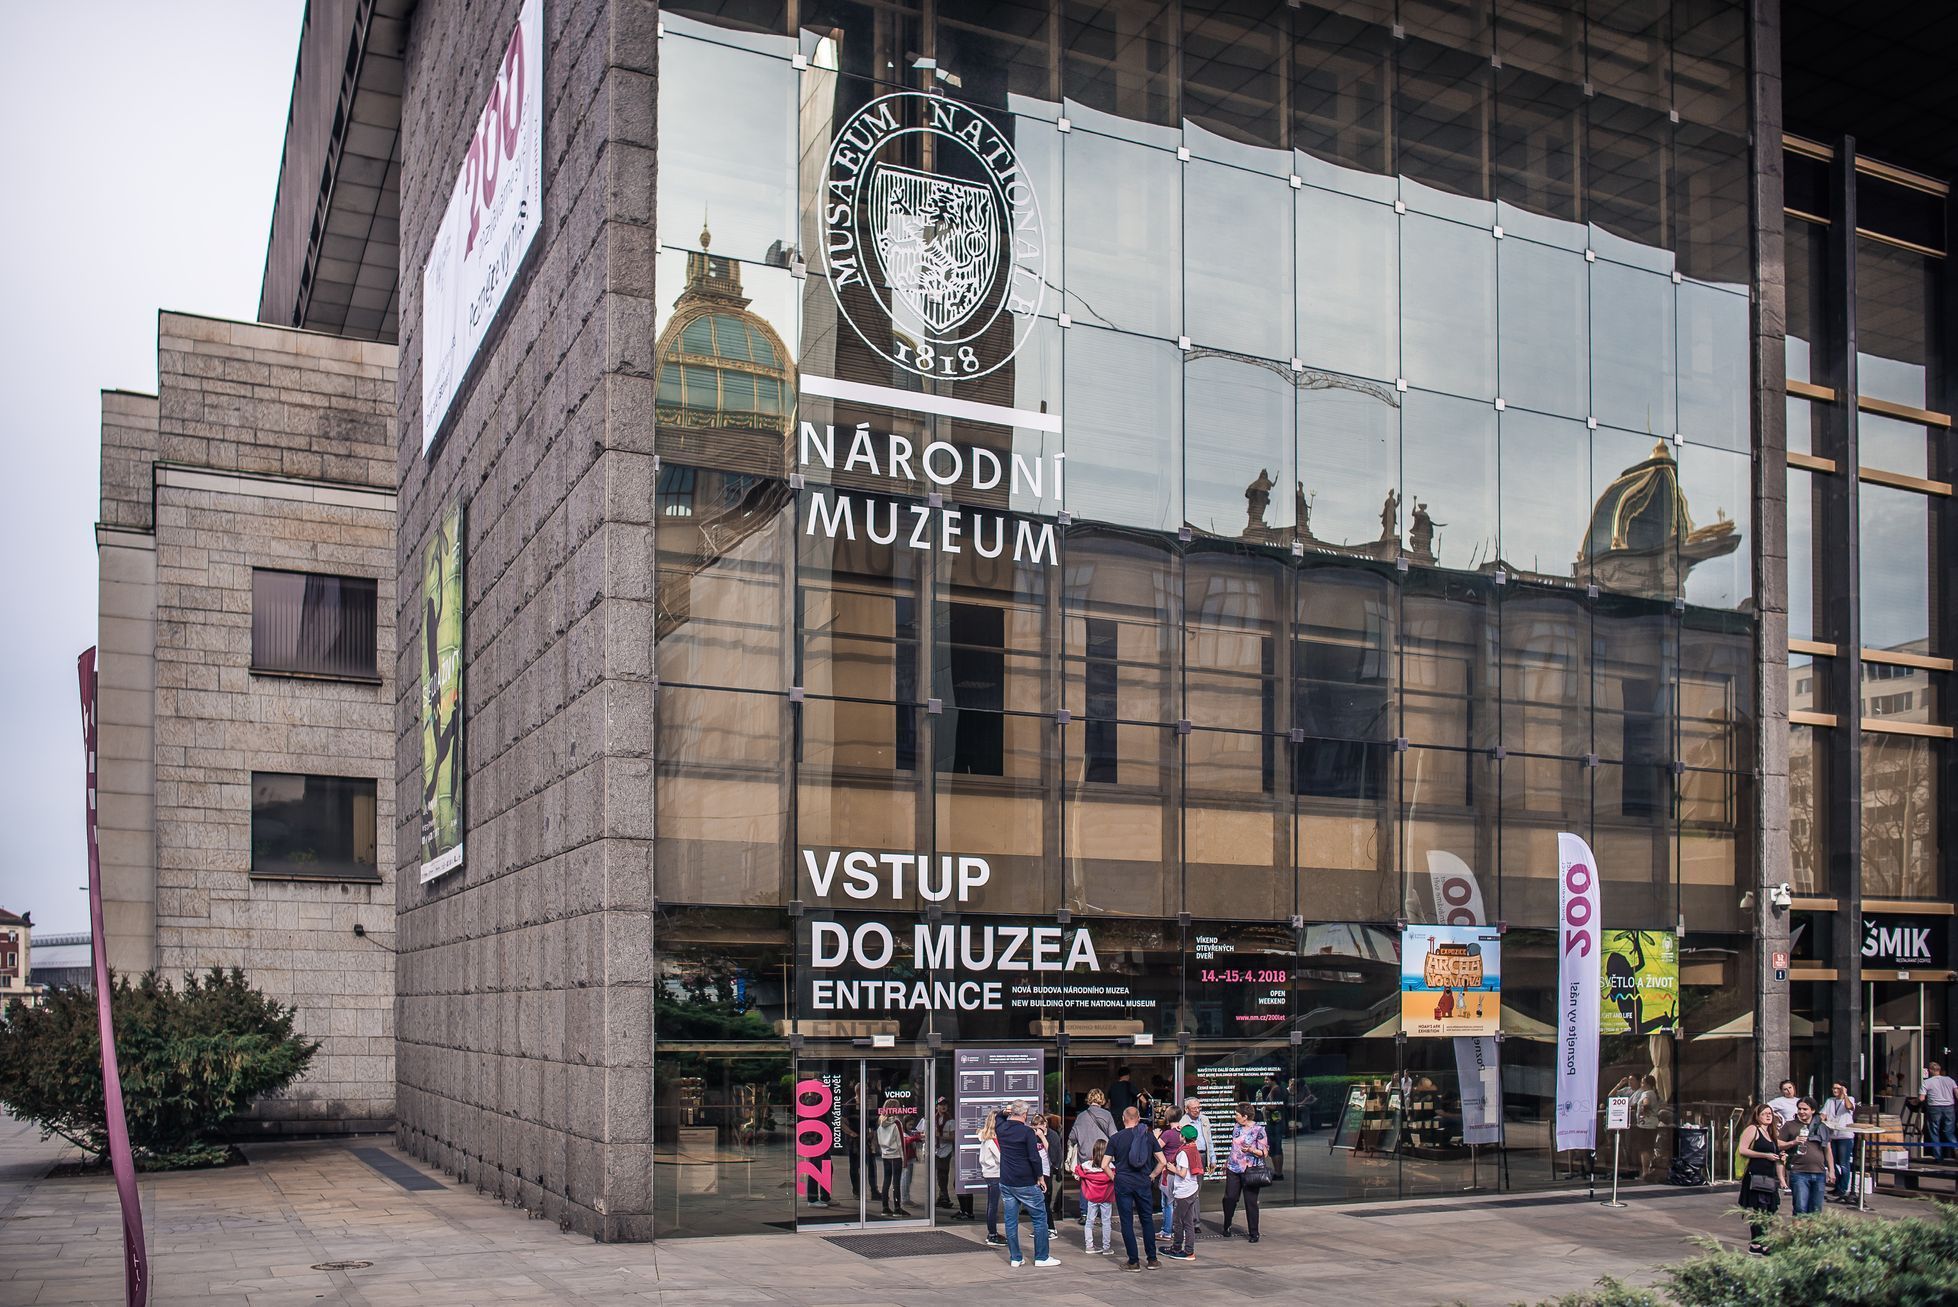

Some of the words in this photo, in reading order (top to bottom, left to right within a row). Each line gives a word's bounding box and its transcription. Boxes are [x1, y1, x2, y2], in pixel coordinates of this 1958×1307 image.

[464, 20, 525, 263] 200
[824, 99, 900, 294] MUSAEUM
[930, 99, 1043, 321] NATIONALE
[894, 340, 979, 377] 1818
[800, 420, 1066, 502] NÁRODNÍ
[806, 491, 1060, 566] MUZEUM
[803, 849, 991, 902] VSTUP
[811, 921, 894, 970] DO
[913, 923, 1100, 972] MUZEA
[1196, 935, 1218, 944] VÍKEND
[1196, 944, 1234, 952] OTEVŘENÝCH
[1861, 920, 1931, 958] ŠMIK
[1196, 952, 1214, 960] DVEŘÍ
[1012, 985, 1031, 994] NOVÁ
[1033, 986, 1062, 994] BUDOVA
[1063, 985, 1104, 994] NÁRODNÍHO
[1245, 970, 1256, 982] 4.
[1258, 970, 1286, 982] 2018
[1599, 974, 1635, 988] SVĚTLO
[1637, 977, 1644, 988] A
[1646, 974, 1673, 988] ŽIVOT
[812, 980, 1002, 1010] ENTRANCE
[1012, 999, 1029, 1007] NEW
[822, 1074, 831, 1088] let
[832, 1074, 841, 1094] svět
[832, 1095, 843, 1149] poznáváme
[878, 1106, 917, 1115] ENTRANCE
[796, 1080, 833, 1198] 200
